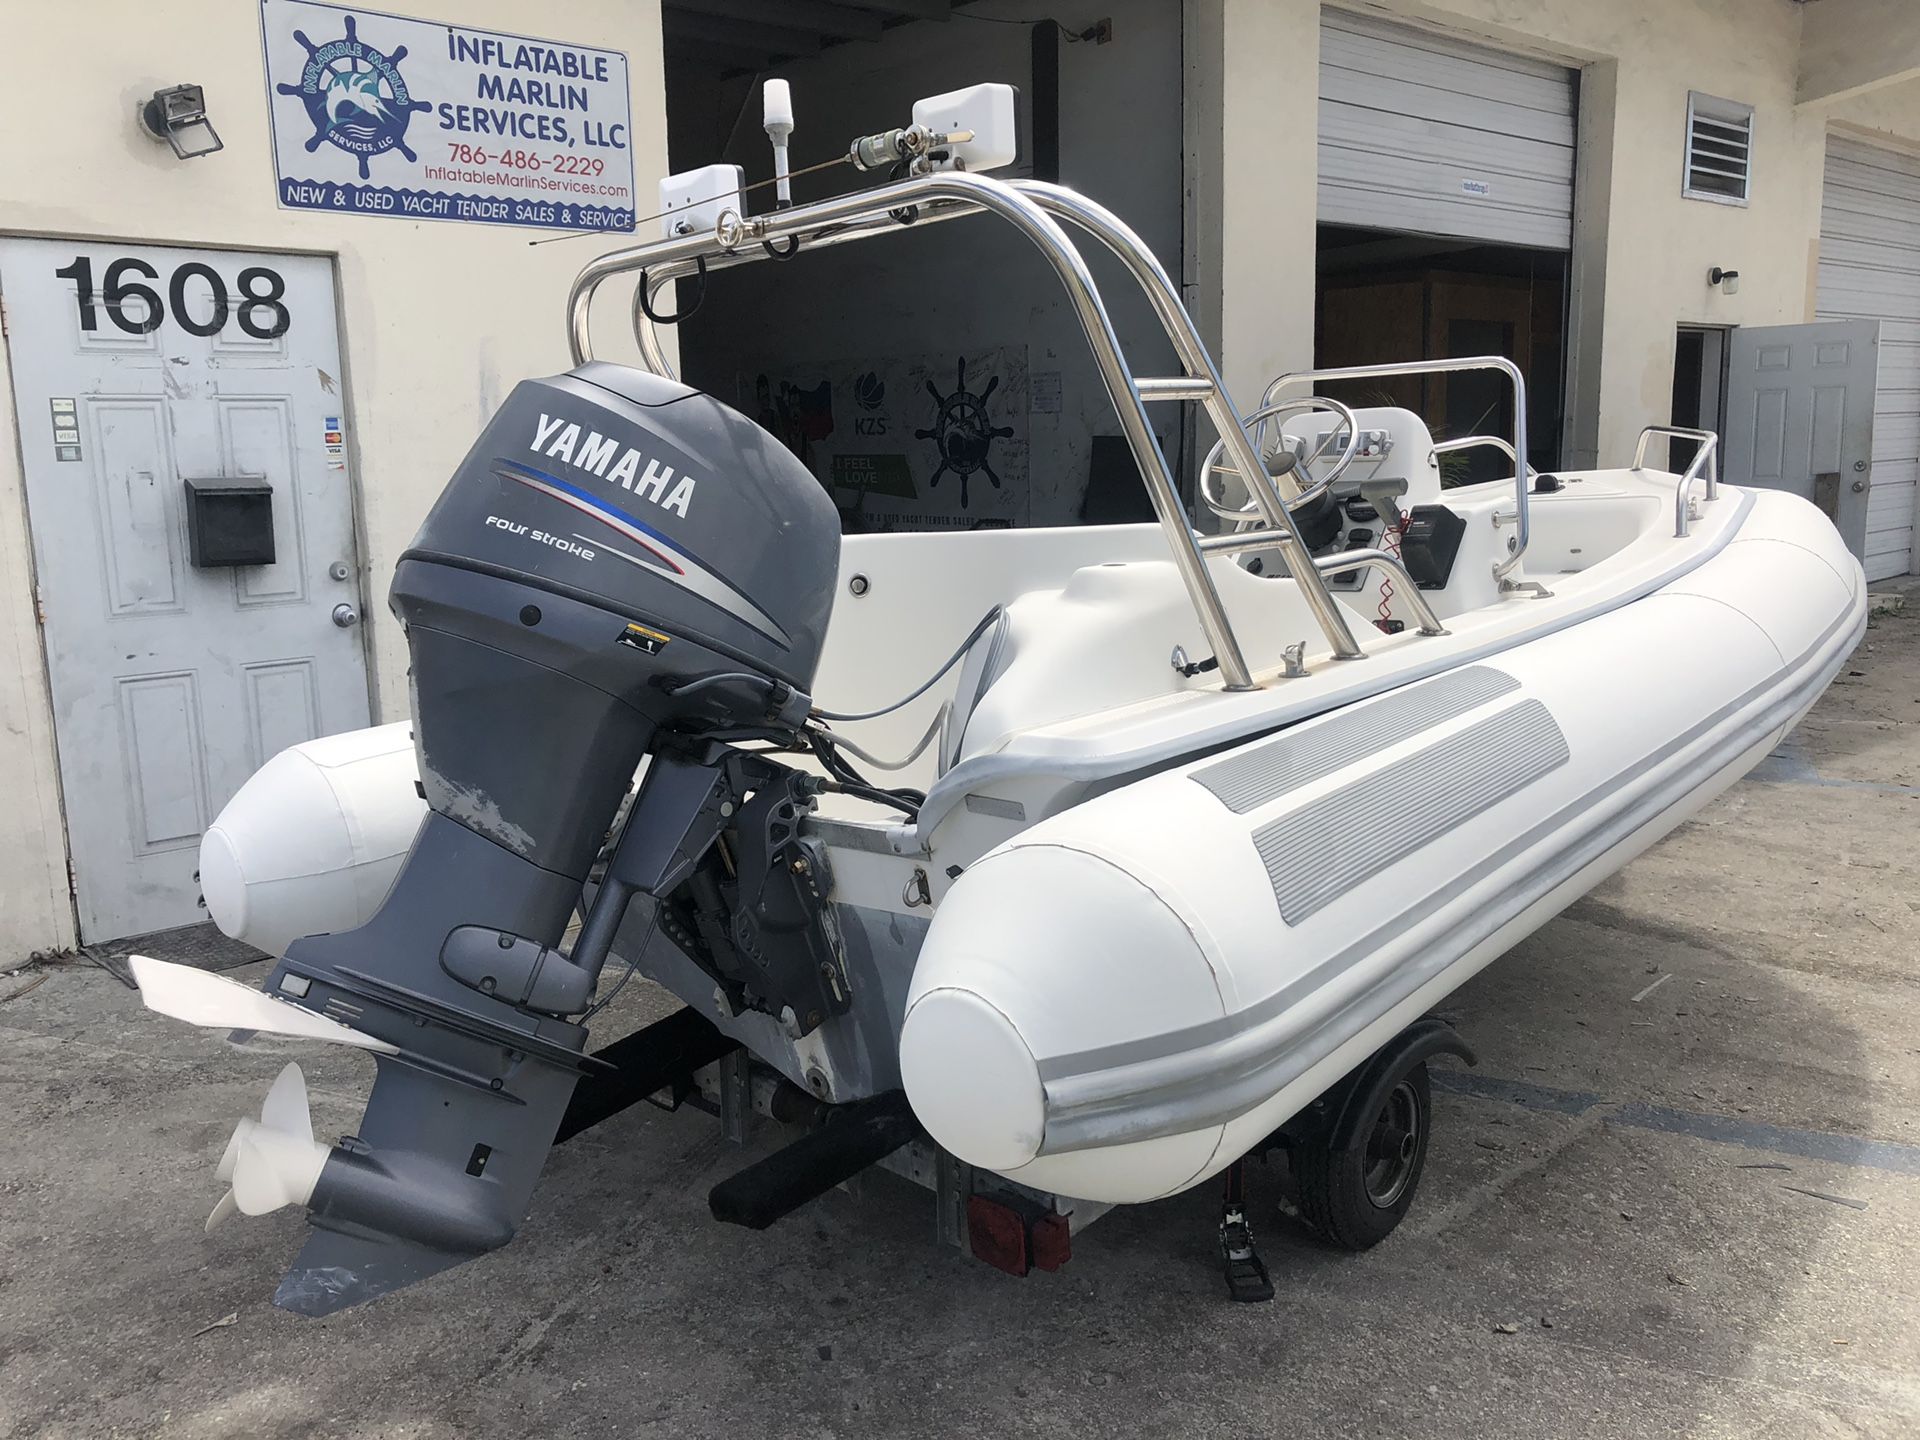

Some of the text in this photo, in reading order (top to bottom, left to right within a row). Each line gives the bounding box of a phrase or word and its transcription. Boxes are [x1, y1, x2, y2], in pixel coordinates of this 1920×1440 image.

[304, 42, 408, 105] INFLATABLE MARLIN
[448, 33, 609, 82] INFLATABLE
[477, 74, 588, 112] MARLIN
[328, 130, 393, 152] SERVICES, LLC
[438, 103, 626, 149] SERVICES, LLC
[447, 143, 605, 177] 786-486-2229
[424, 165, 629, 198] InflatableMarlinServices.com
[286, 185, 632, 230] NEW & USED YACHT TENDER SALES & SERVICE
[55, 256, 291, 340] 1608
[855, 417, 887, 436] KZS
[529, 413, 697, 519] YAMAHA
[845, 457, 874, 470] FEEL
[845, 471, 878, 484] LOVE
